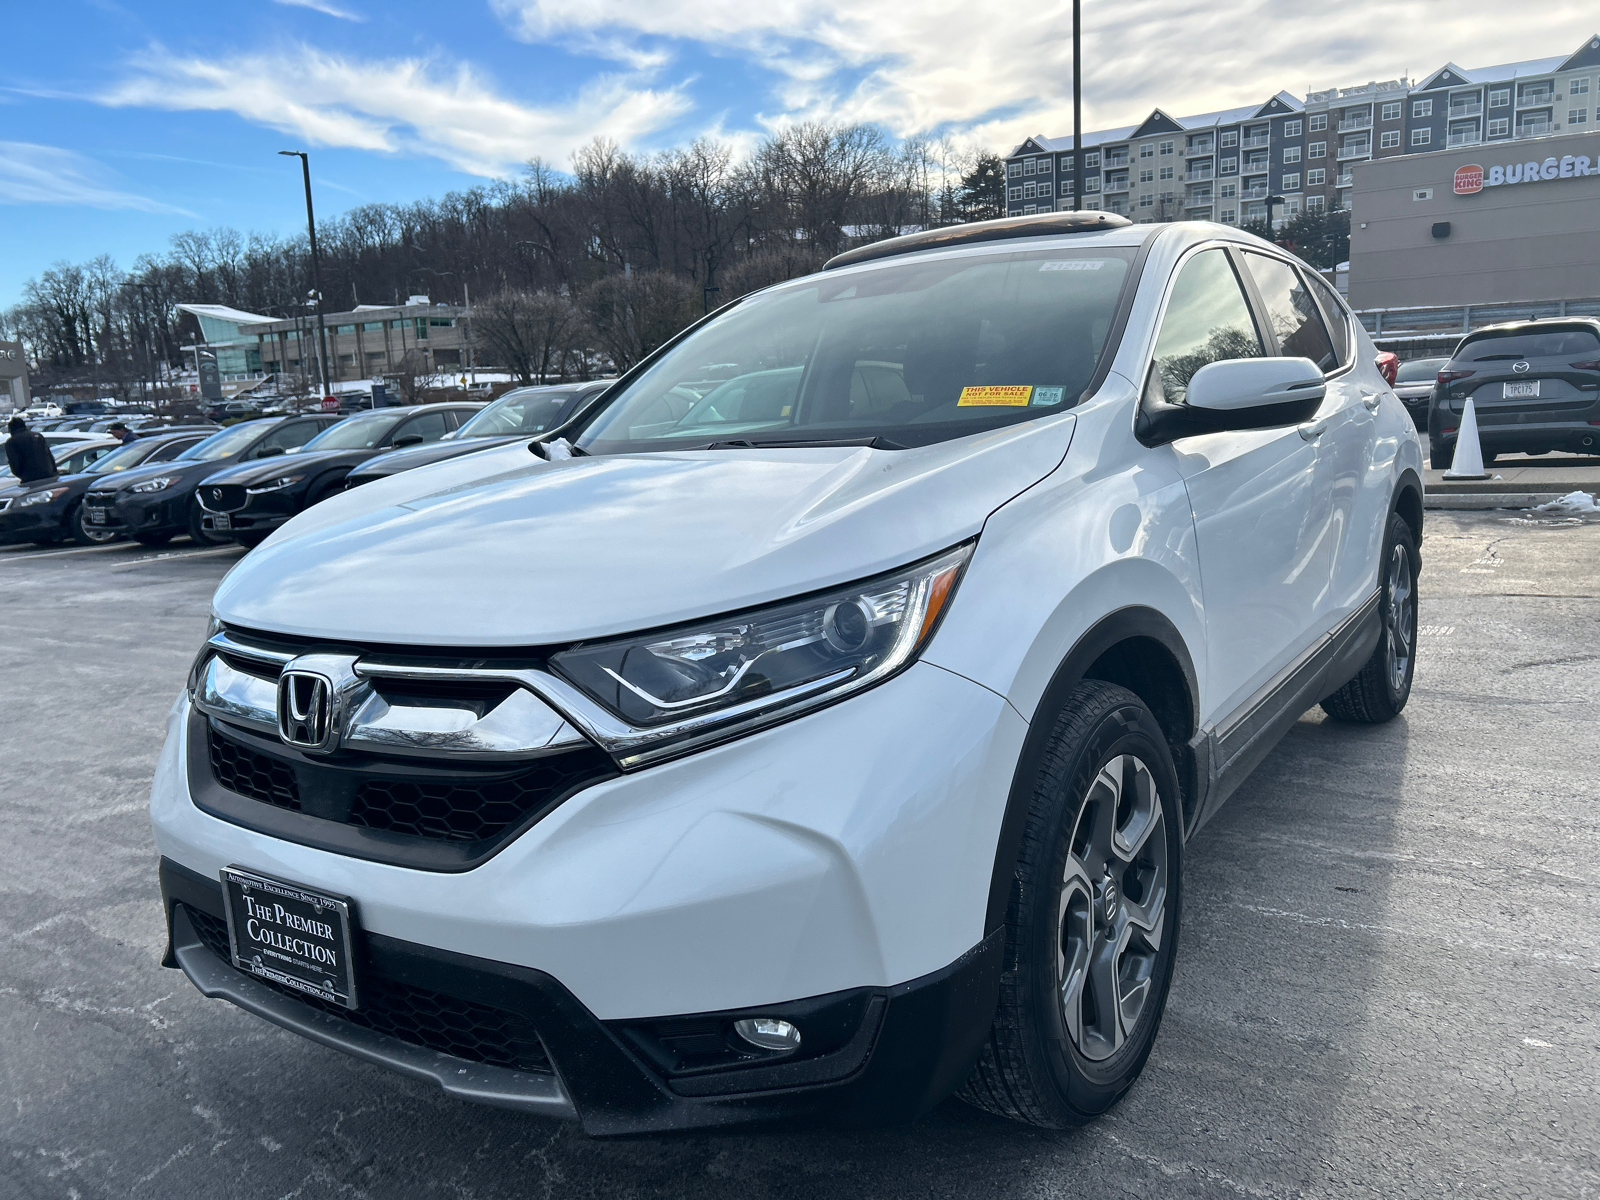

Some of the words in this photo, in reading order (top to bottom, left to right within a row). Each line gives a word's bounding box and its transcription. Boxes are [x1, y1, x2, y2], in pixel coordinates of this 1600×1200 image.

[1454, 179, 1482, 189] KING
[1455, 172, 1482, 180] BURGER
[1489, 155, 1591, 186] BURGER
[263, 882, 300, 899] EXCELLENCE
[300, 892, 318, 904] SINCE
[319, 898, 336, 909] 1995
[242, 894, 274, 923] THE
[272, 902, 335, 941] PREMIER
[246, 918, 337, 967] COLLECTION
